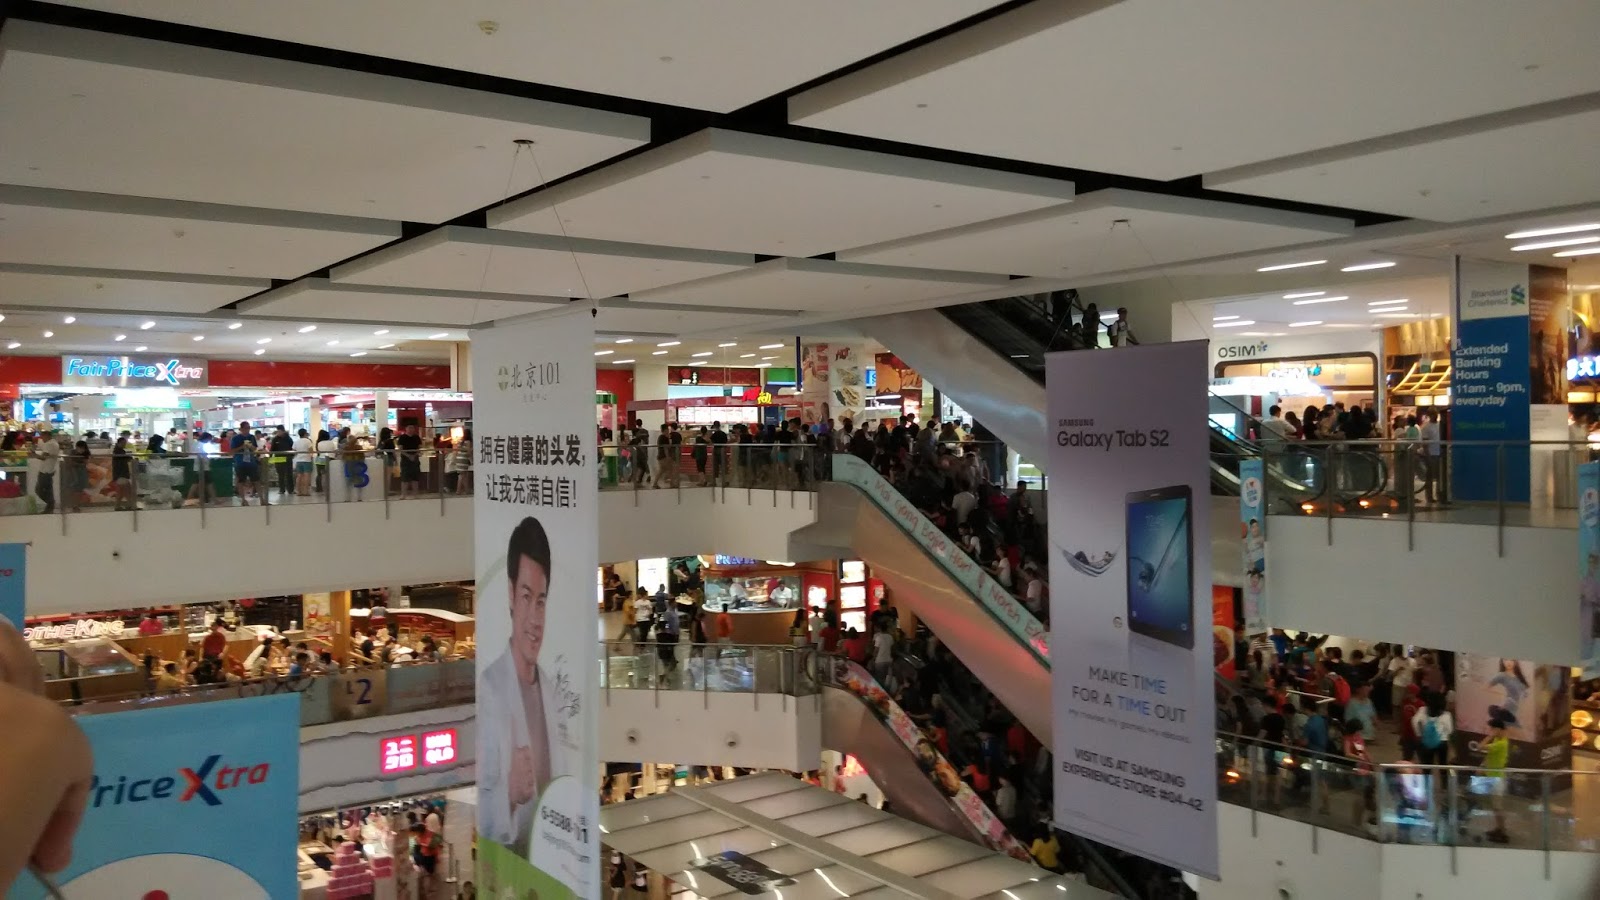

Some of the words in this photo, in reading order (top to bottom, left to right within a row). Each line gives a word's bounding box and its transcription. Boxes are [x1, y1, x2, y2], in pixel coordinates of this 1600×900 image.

[1218, 345, 1256, 358] OSIM
[1455, 343, 1508, 356] Extended
[1455, 356, 1501, 368] Banking
[510, 361, 560, 389] 北京101
[1455, 370, 1489, 380] Hours
[1456, 384, 1486, 393] 11am
[1496, 382, 1525, 393] 9pm,
[1455, 396, 1506, 407] everyday
[1057, 431, 1113, 451] Galaxy
[1115, 430, 1146, 446] Tab
[1150, 430, 1169, 446] S2
[1089, 666, 1128, 687] MAKE
[1132, 674, 1167, 695] TIME
[1071, 686, 1099, 704] FOR
[1103, 693, 1112, 707] A
[1117, 695, 1150, 716] TIME
[1154, 704, 1187, 723] OUT
[1074, 748, 1098, 763] VISIT
[1100, 755, 1115, 769] US
[1116, 760, 1129, 772] AT
[1130, 763, 1186, 788] SAMSUNG
[179, 754, 270, 806] Xtra
[1062, 761, 1120, 788] EXPERIENCE
[1122, 778, 1157, 798] STORE
